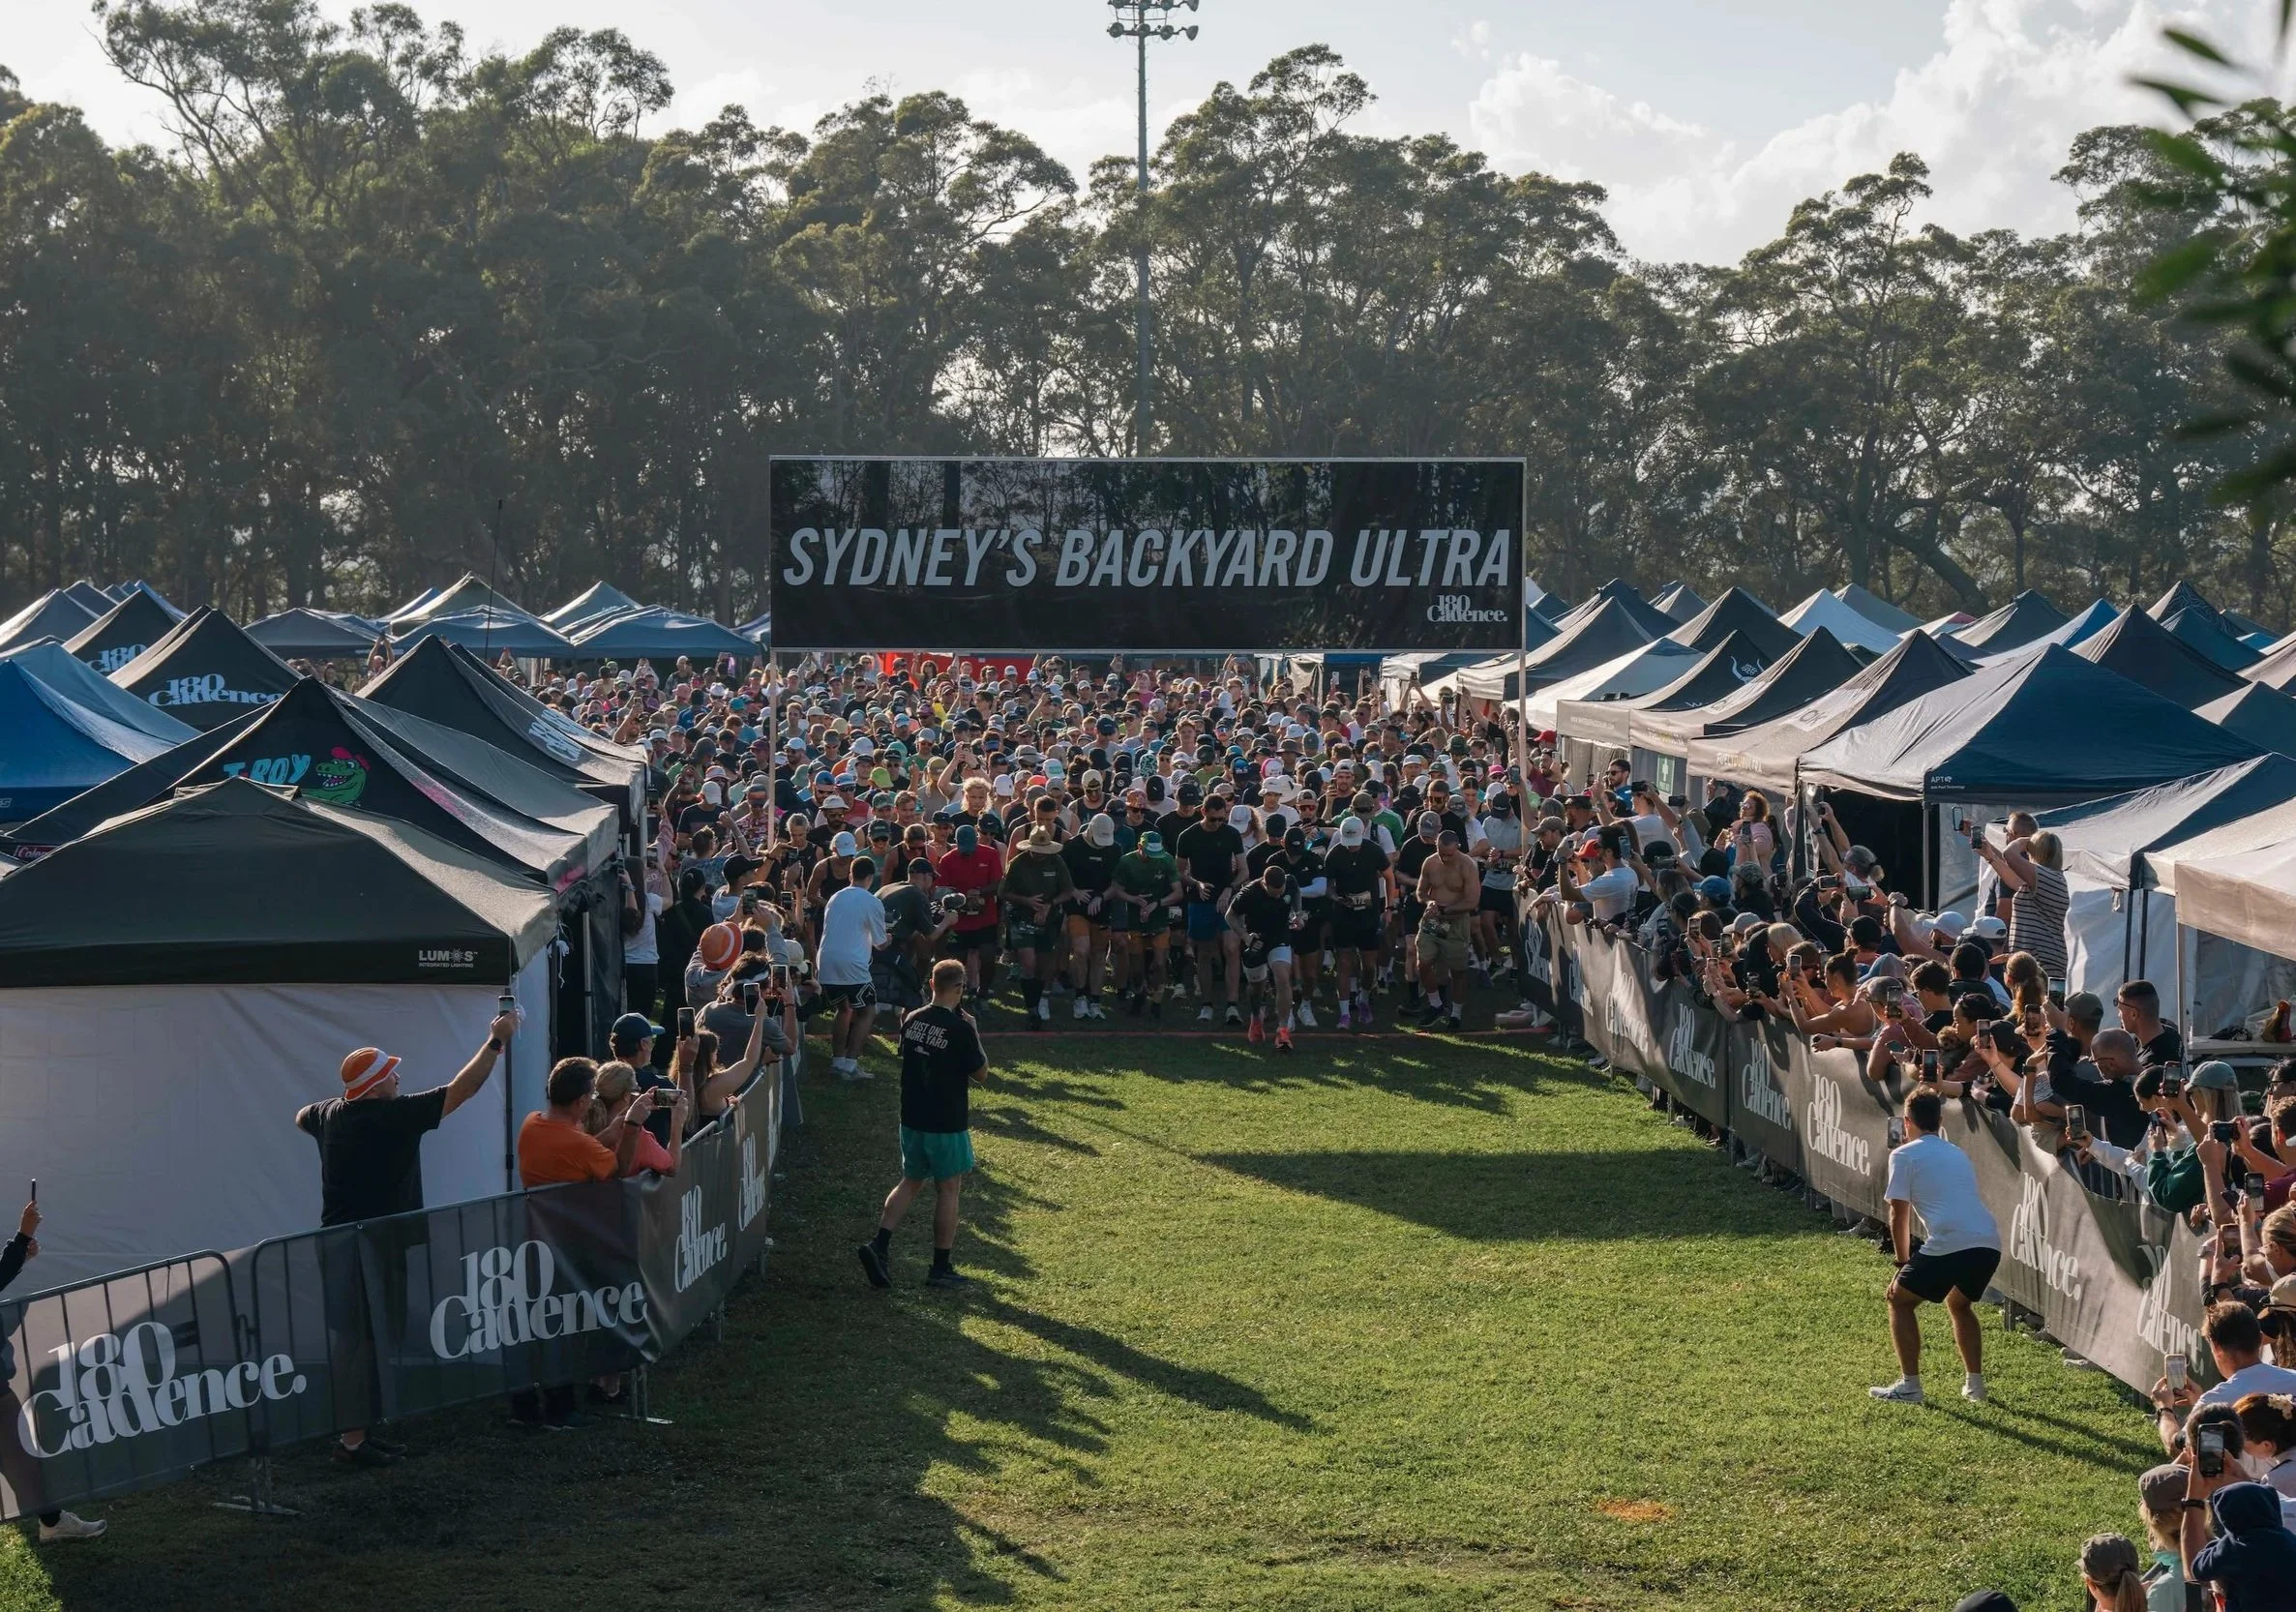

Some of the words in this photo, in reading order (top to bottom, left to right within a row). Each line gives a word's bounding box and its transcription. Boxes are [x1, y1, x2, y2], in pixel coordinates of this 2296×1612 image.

[783, 527, 1043, 587] SYDNEY'S
[1055, 529, 1335, 587] BACKYARD
[1350, 529, 1511, 587] ULTRA
[1437, 594, 1471, 612] 180
[166, 673, 224, 698] 180
[905, 1029, 926, 1043] MORE
[926, 1034, 948, 1049] YARD
[909, 1020, 930, 1034] JUST
[928, 1025, 948, 1038] ONE
[1750, 1037, 1771, 1087] 180
[1814, 1074, 1842, 1128] 180
[459, 1239, 555, 1315] 180
[47, 1322, 176, 1410] 180
